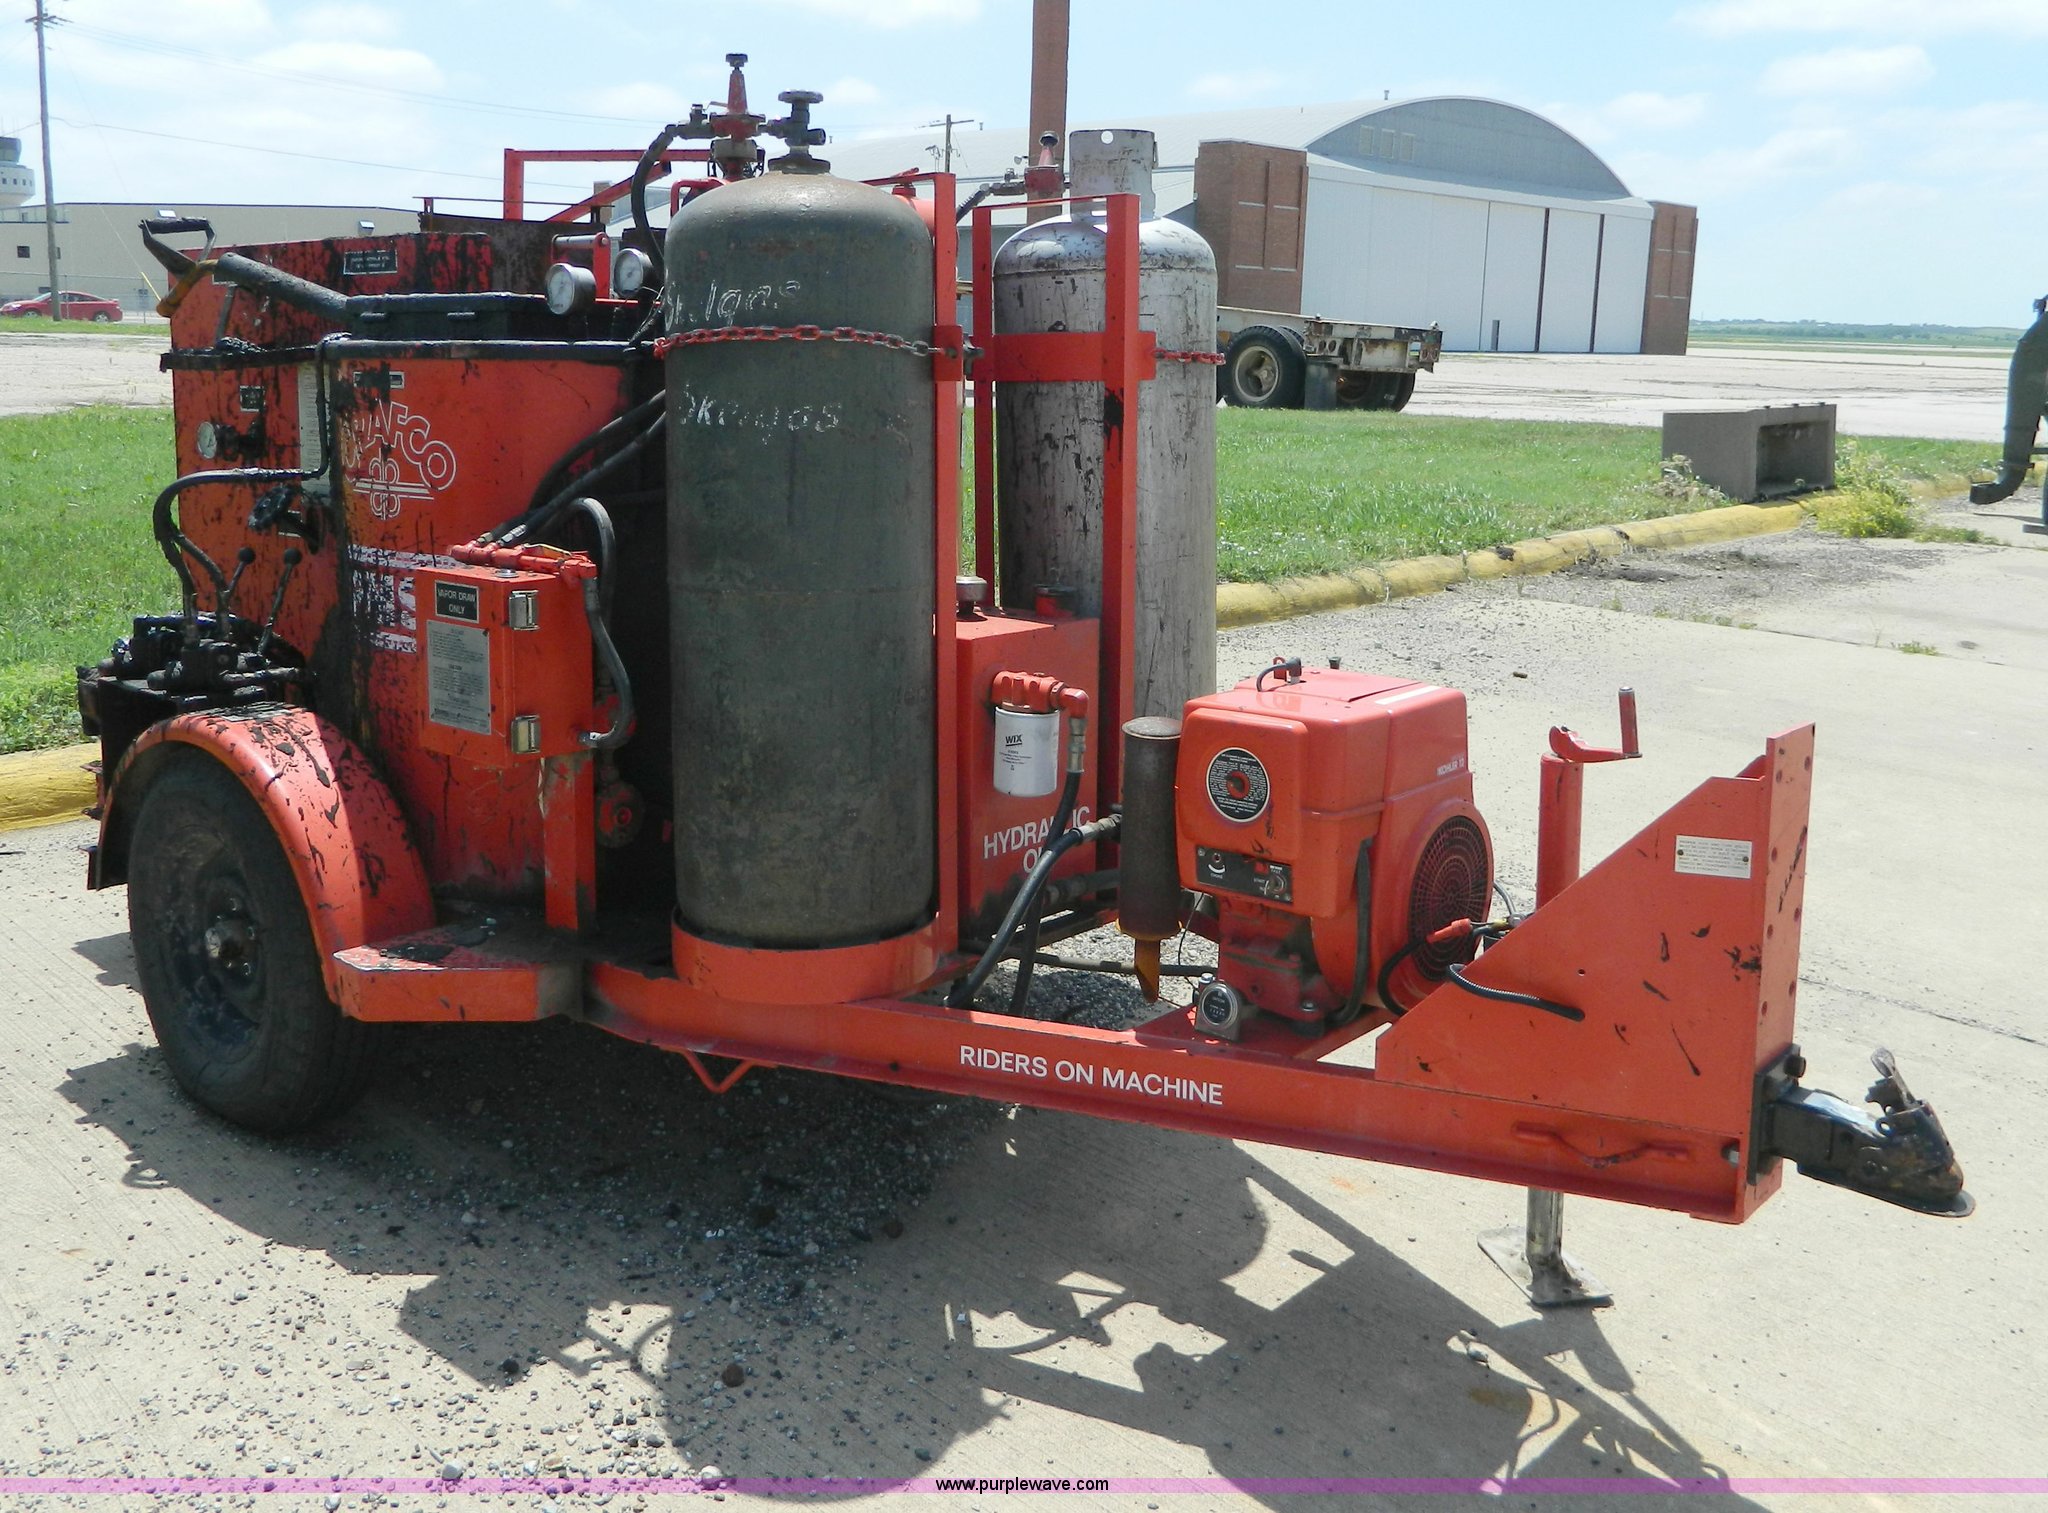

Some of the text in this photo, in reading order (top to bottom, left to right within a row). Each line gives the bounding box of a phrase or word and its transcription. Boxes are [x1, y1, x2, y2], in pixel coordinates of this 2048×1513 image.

[438, 588, 457, 600] VAPOR
[448, 603, 465, 615] ONLY
[1005, 734, 1022, 744] WIX
[984, 806, 1090, 859] HYDRAIC
[960, 1045, 1223, 1105] RIDERS ON MACHINE
